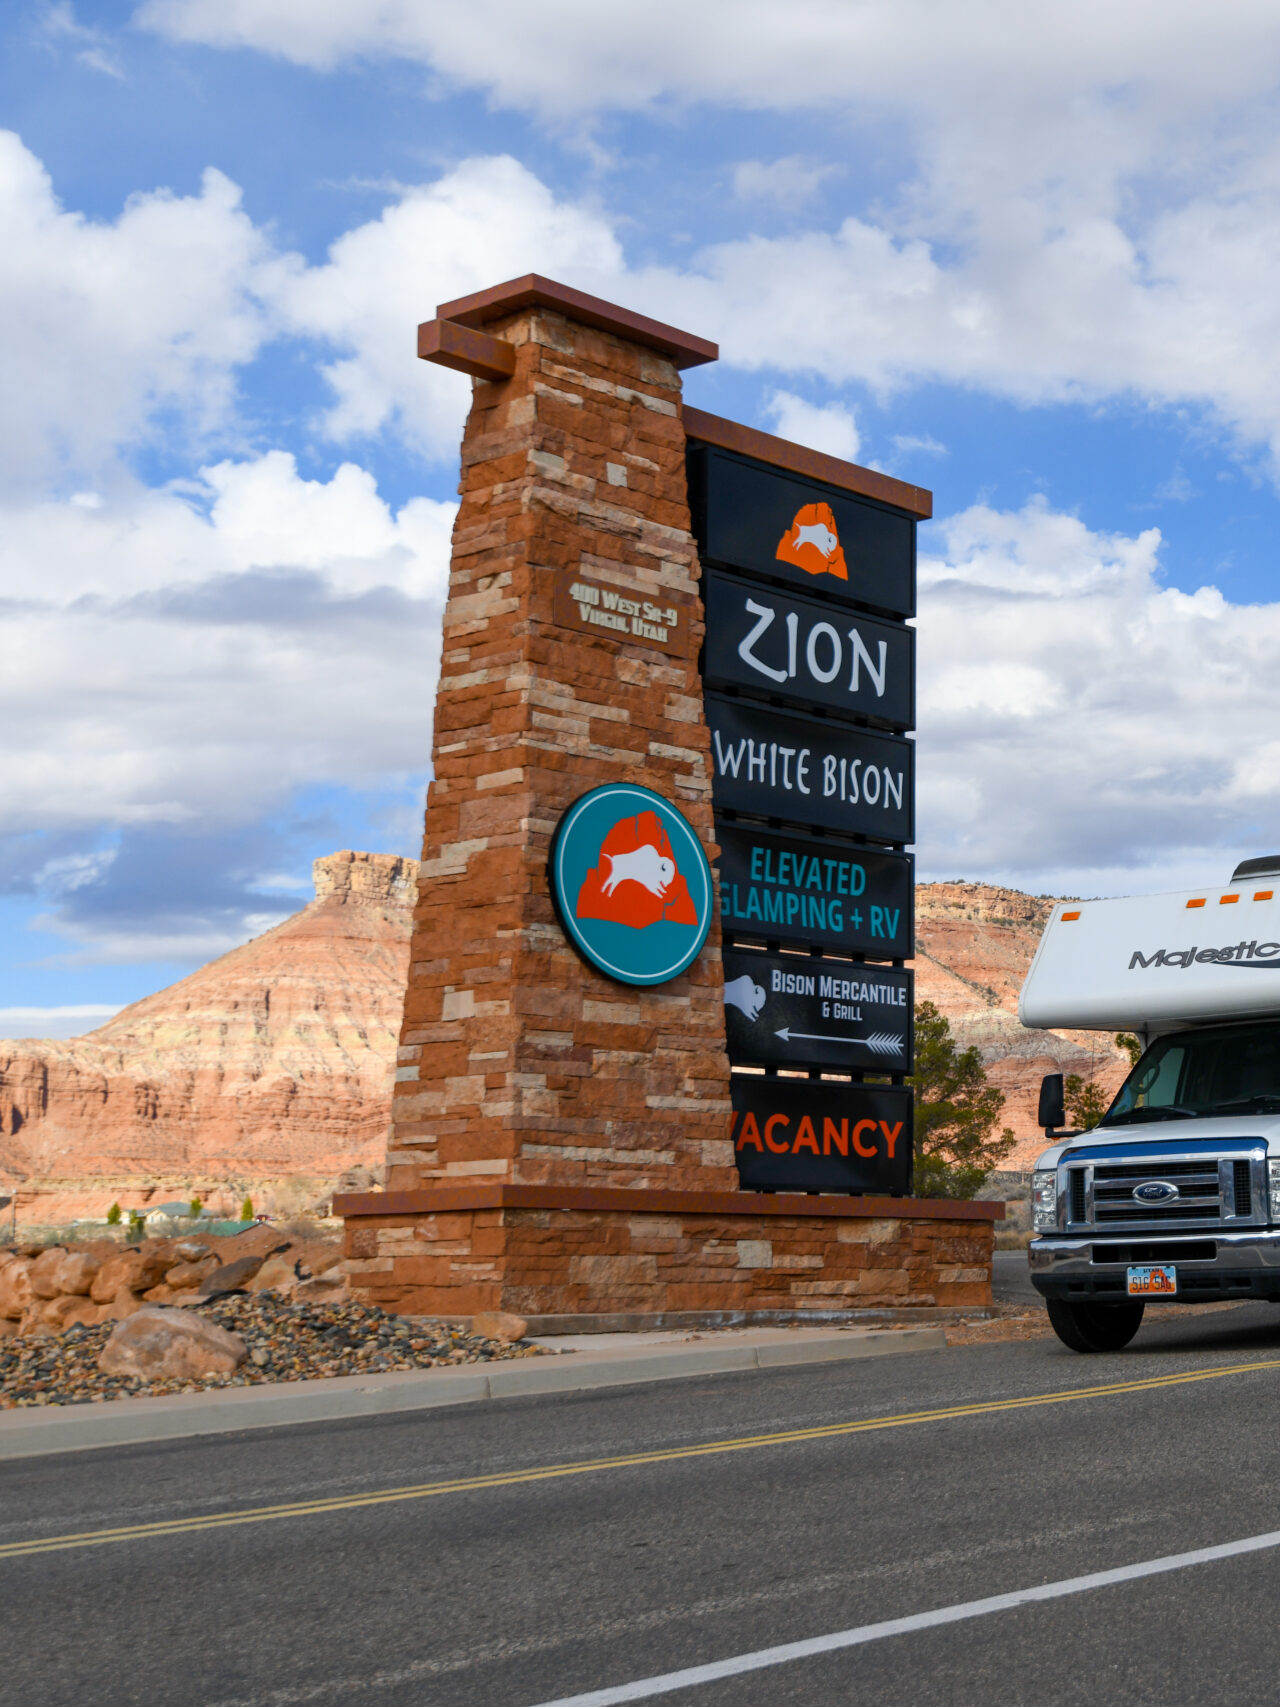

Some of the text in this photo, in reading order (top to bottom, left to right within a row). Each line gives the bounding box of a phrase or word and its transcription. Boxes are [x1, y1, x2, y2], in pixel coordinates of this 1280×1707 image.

[738, 598, 888, 698] ZION
[714, 730, 904, 811] WHITE BISON
[751, 846, 867, 897] ELEVATED
[720, 881, 845, 933] GLAMPING
[870, 904, 901, 940] RV
[822, 1001, 830, 1018] &
